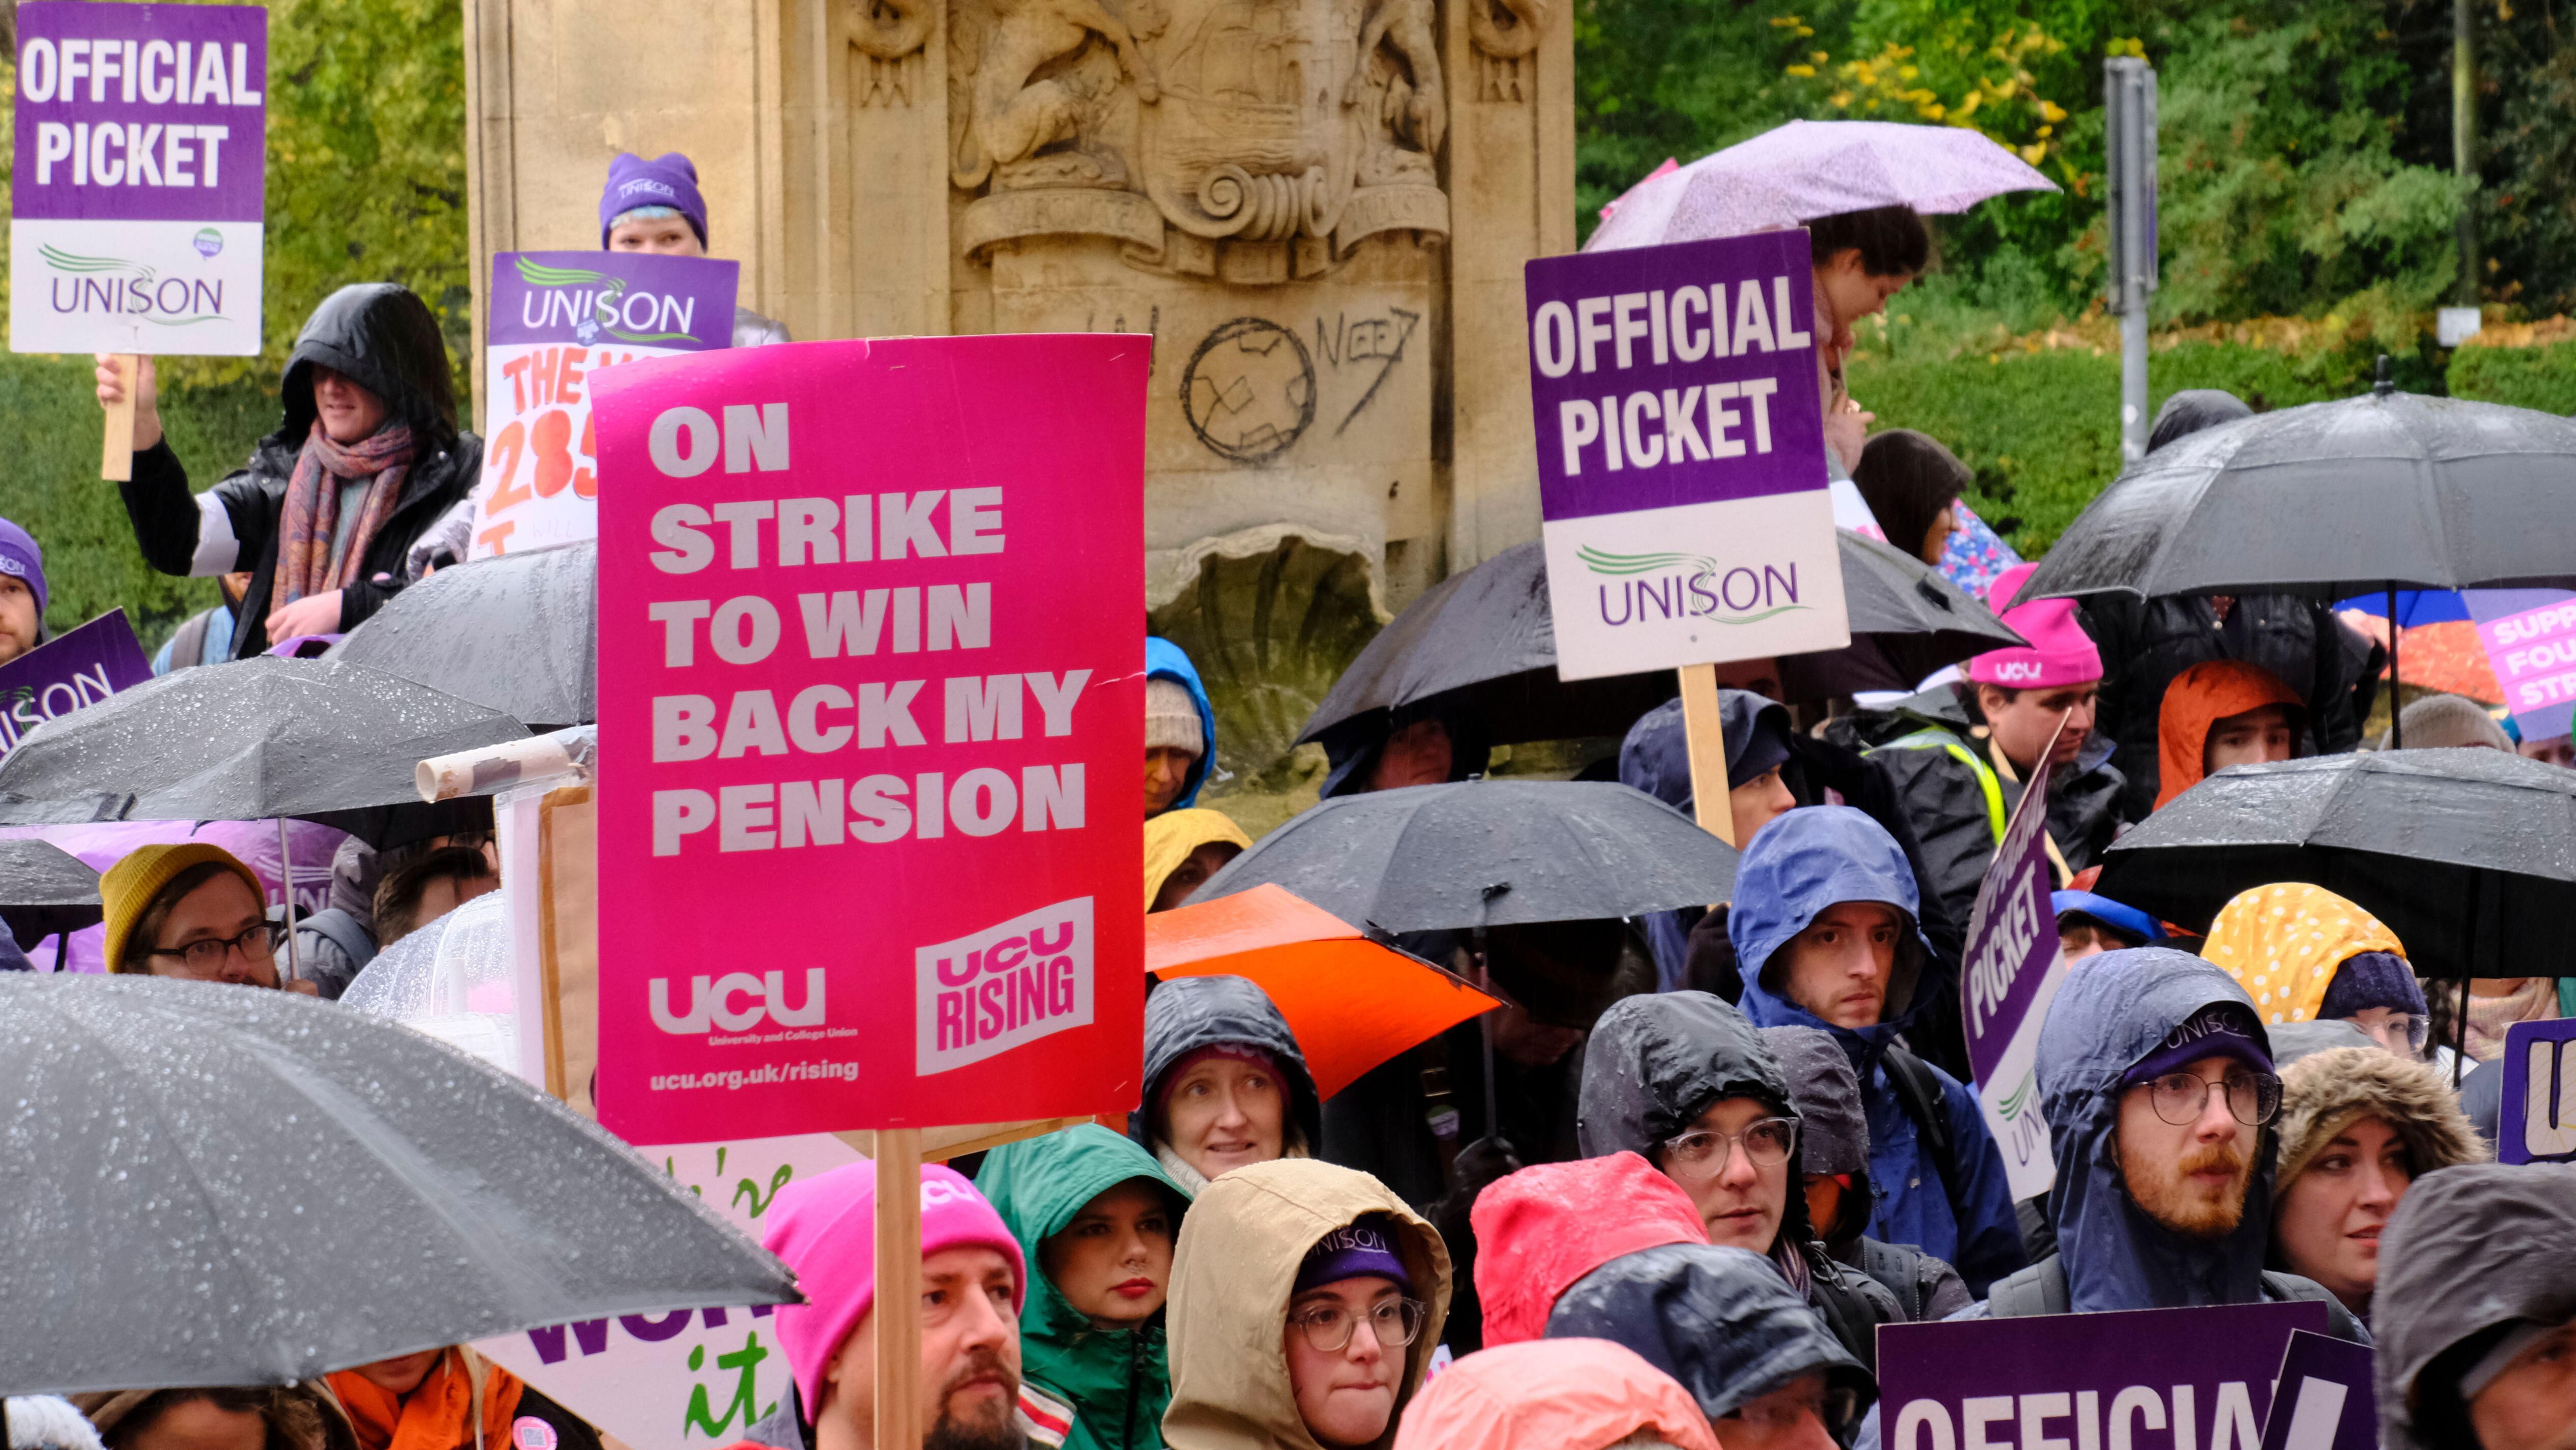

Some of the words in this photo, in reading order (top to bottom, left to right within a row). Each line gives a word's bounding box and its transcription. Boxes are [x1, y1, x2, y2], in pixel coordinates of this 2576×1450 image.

[21, 37, 261, 106] OFFICIAL
[36, 121, 228, 188] PICKET
[619, 180, 675, 199] UNISON
[53, 278, 222, 314] UNISON
[522, 290, 694, 334] UNISON
[1534, 276, 1811, 378] OFFICIAL
[503, 347, 588, 414] THE
[649, 402, 789, 478] ON
[1560, 378, 1777, 476] PICKET
[650, 486, 1006, 574] STRIKE
[649, 595, 781, 668] TO
[799, 583, 991, 658] WIN
[1600, 561, 1799, 626] UNISON
[2494, 605, 2576, 645] SUPP
[1996, 662, 2042, 680] UCU
[0, 663, 114, 753] ISON
[653, 680, 926, 763] BACK
[945, 670, 1093, 743] MY
[653, 763, 1085, 857] PENSION
[937, 921, 1074, 987] UCU
[1970, 860, 2040, 1039] PICKET
[649, 968, 826, 1035] UCU
[937, 955, 1074, 1052] RISING
[709, 1033, 763, 1047] University
[764, 1032, 783, 1042] and
[785, 1029, 826, 1041] College
[827, 1027, 858, 1038] Union
[651, 1060, 859, 1091] ucu.org.uk/rising
[685, 1330, 777, 1439] it
[1893, 1380, 2277, 1450] OFFICIA
